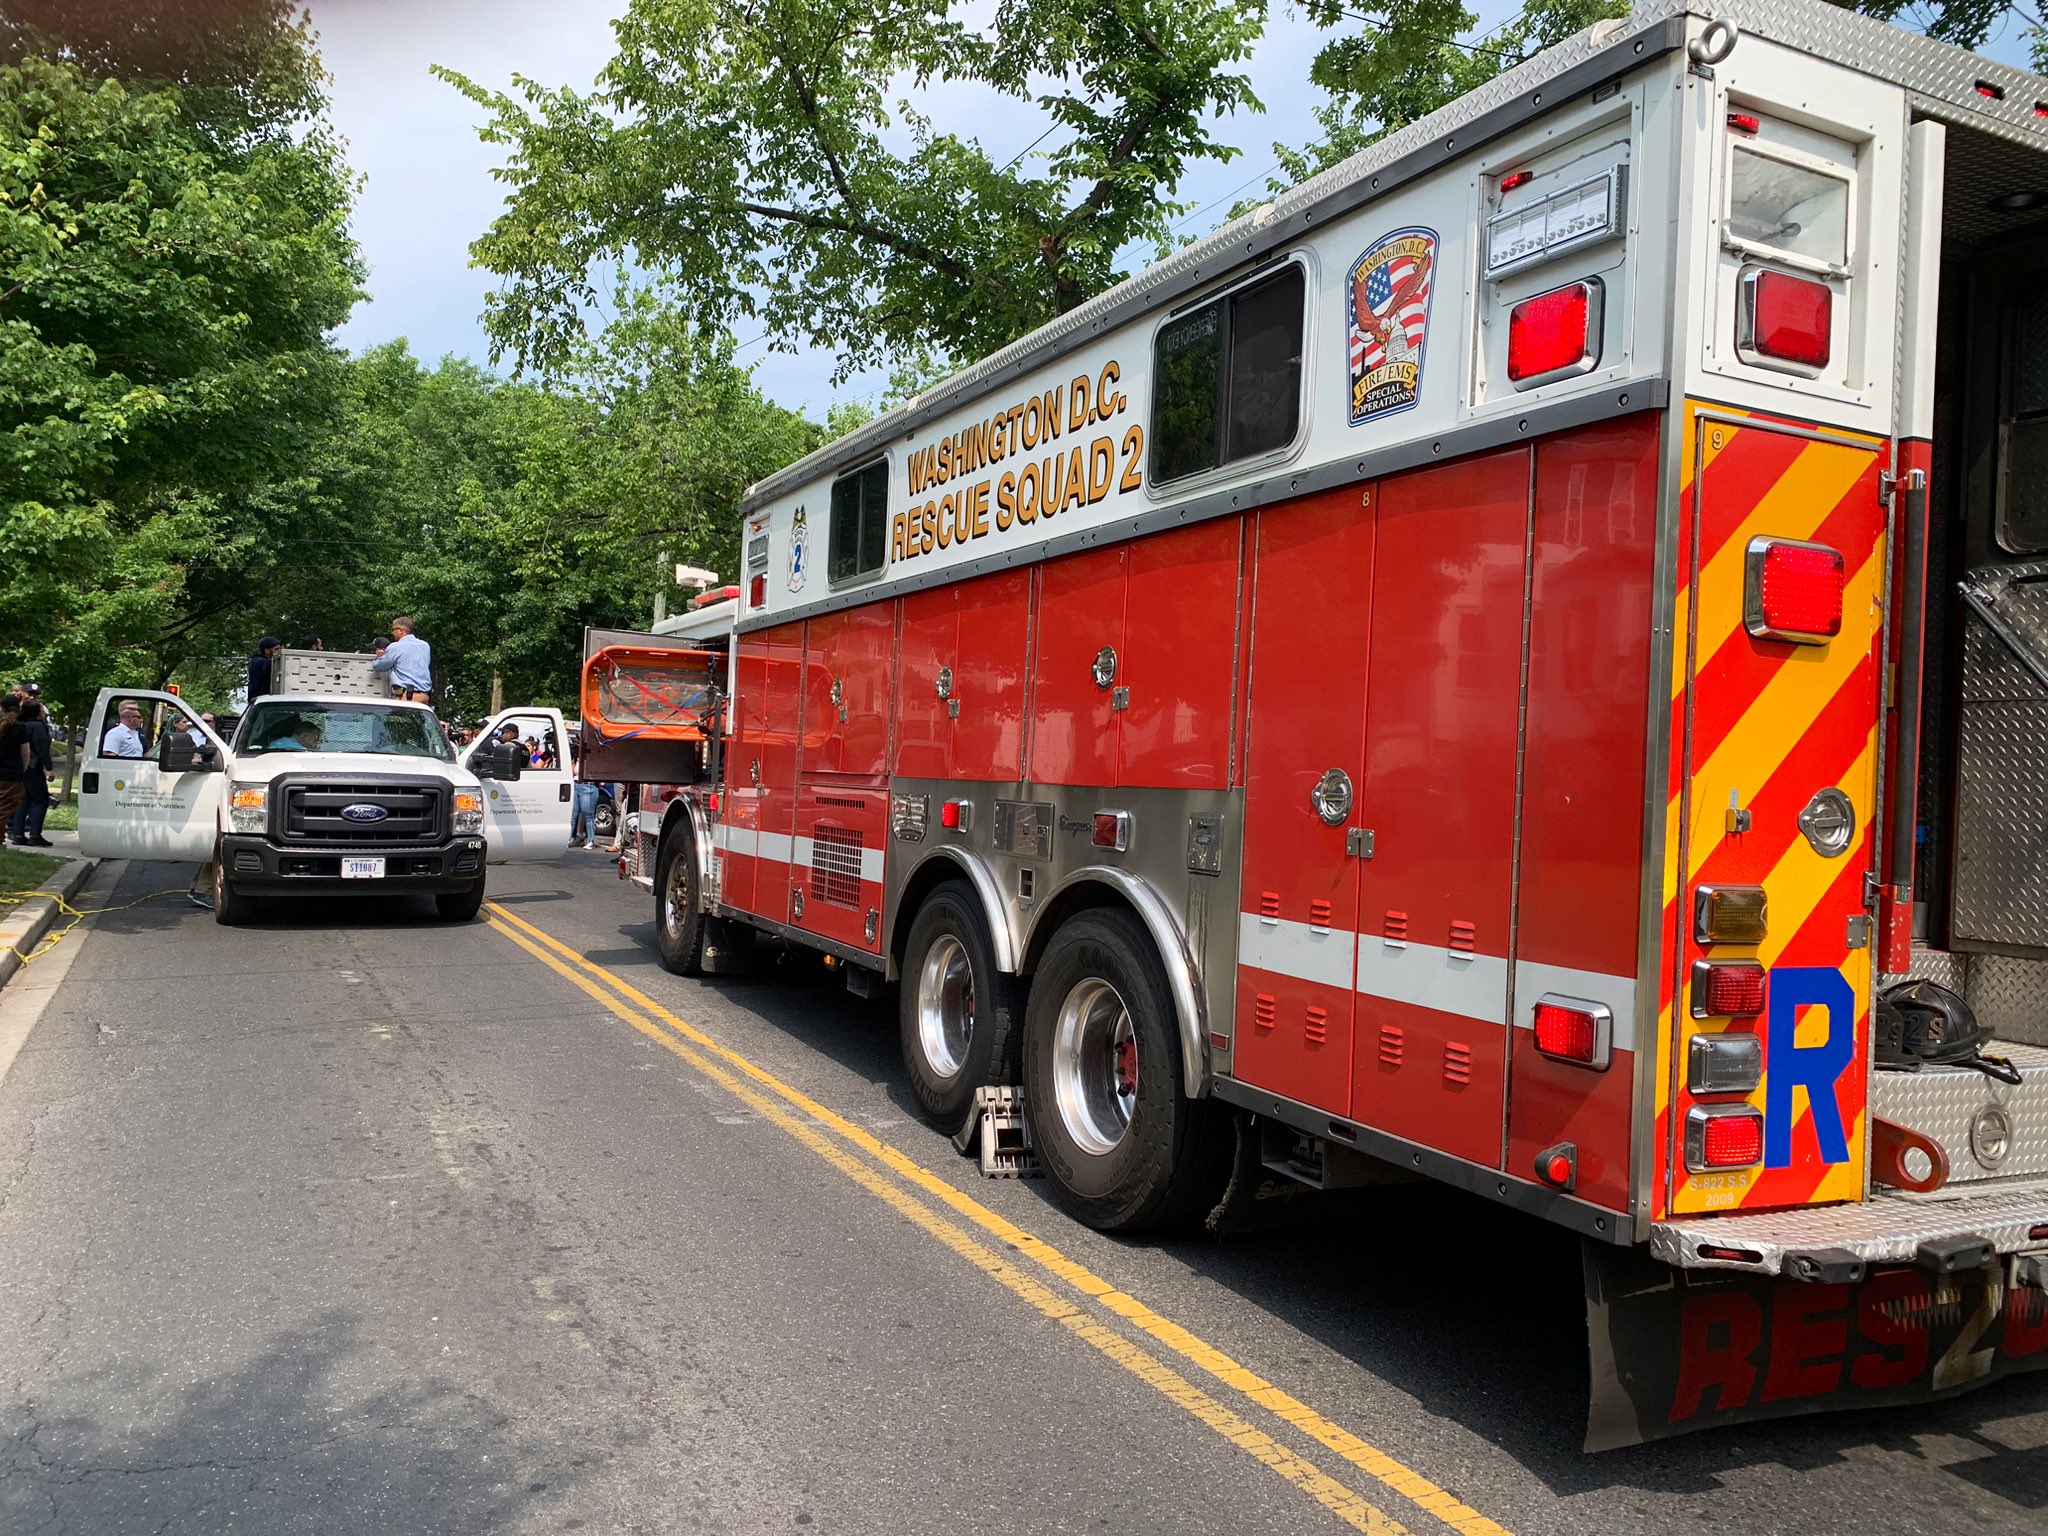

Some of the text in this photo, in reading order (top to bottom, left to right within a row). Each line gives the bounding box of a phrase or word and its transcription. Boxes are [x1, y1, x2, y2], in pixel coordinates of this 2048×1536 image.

[1357, 364, 1412, 394] FIRE/EMS
[1366, 383, 1402, 402] SPECIAL
[1356, 390, 1411, 415] OPERATIONS
[908, 360, 1127, 497] WASHINGTON D.C.
[1709, 429, 1726, 450] 9
[891, 424, 1144, 564] RESCUE SQUAD 2
[1362, 491, 1371, 507] 8
[793, 544, 802, 574] 2
[1119, 551, 1126, 564] 7
[115, 800, 150, 809] Department
[352, 807, 377, 818] Ford
[489, 808, 517, 816] Department
[1764, 967, 1855, 1169] R
[1690, 1176, 1725, 1192] S-822
[1705, 1191, 1735, 1207] 2009
